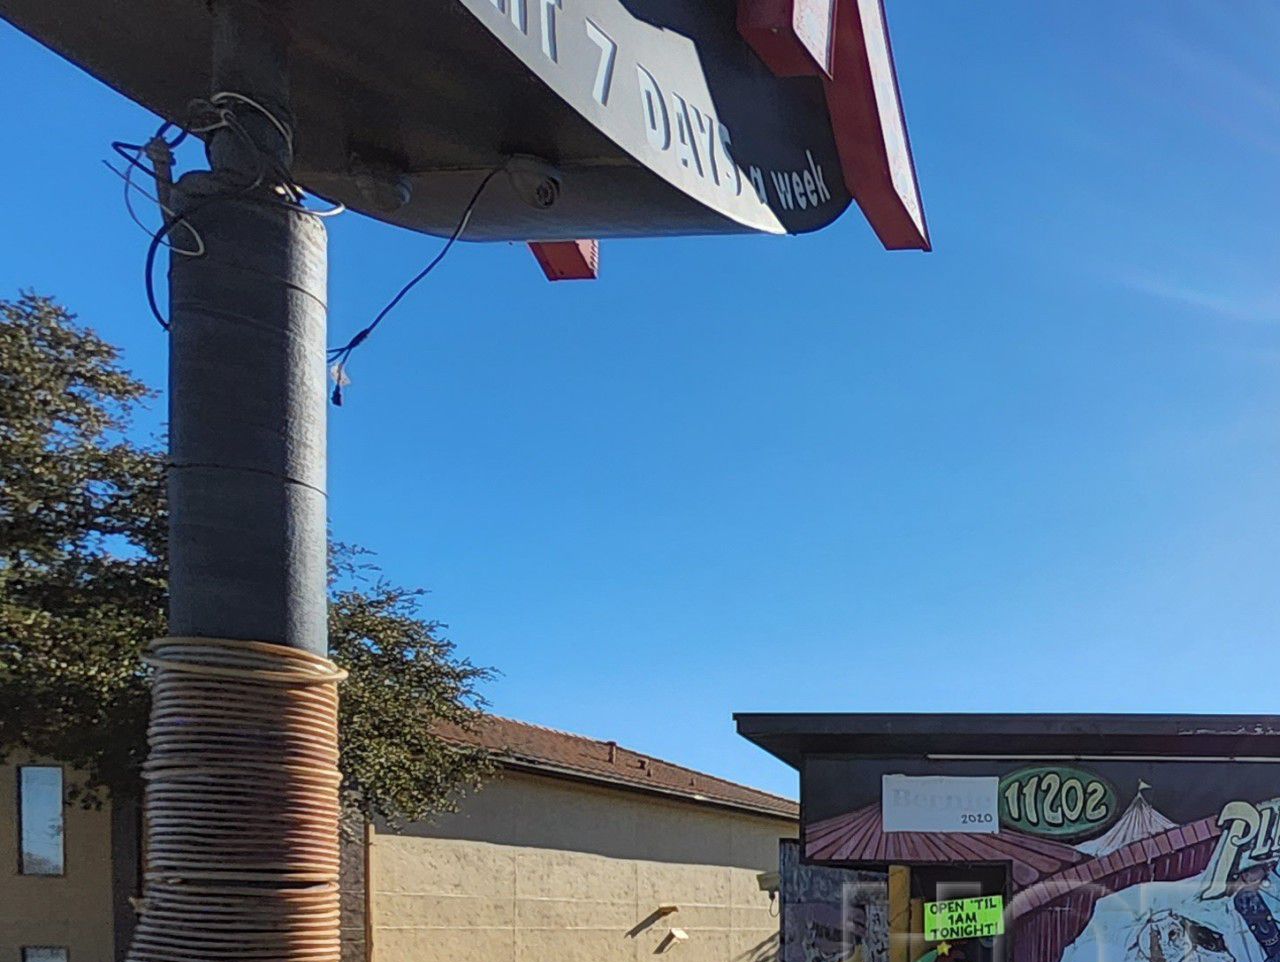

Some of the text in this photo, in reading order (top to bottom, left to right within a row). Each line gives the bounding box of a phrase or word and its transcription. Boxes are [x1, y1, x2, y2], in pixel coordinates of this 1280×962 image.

[584, 17, 617, 107] 7
[637, 63, 742, 196] DAYS
[771, 150, 831, 210] week
[1005, 773, 1108, 826] 11202
[961, 813, 993, 825] 2020
[929, 901, 964, 915] OPEN
[948, 911, 978, 926] 1AM
[929, 921, 999, 939] TONIGHT!
